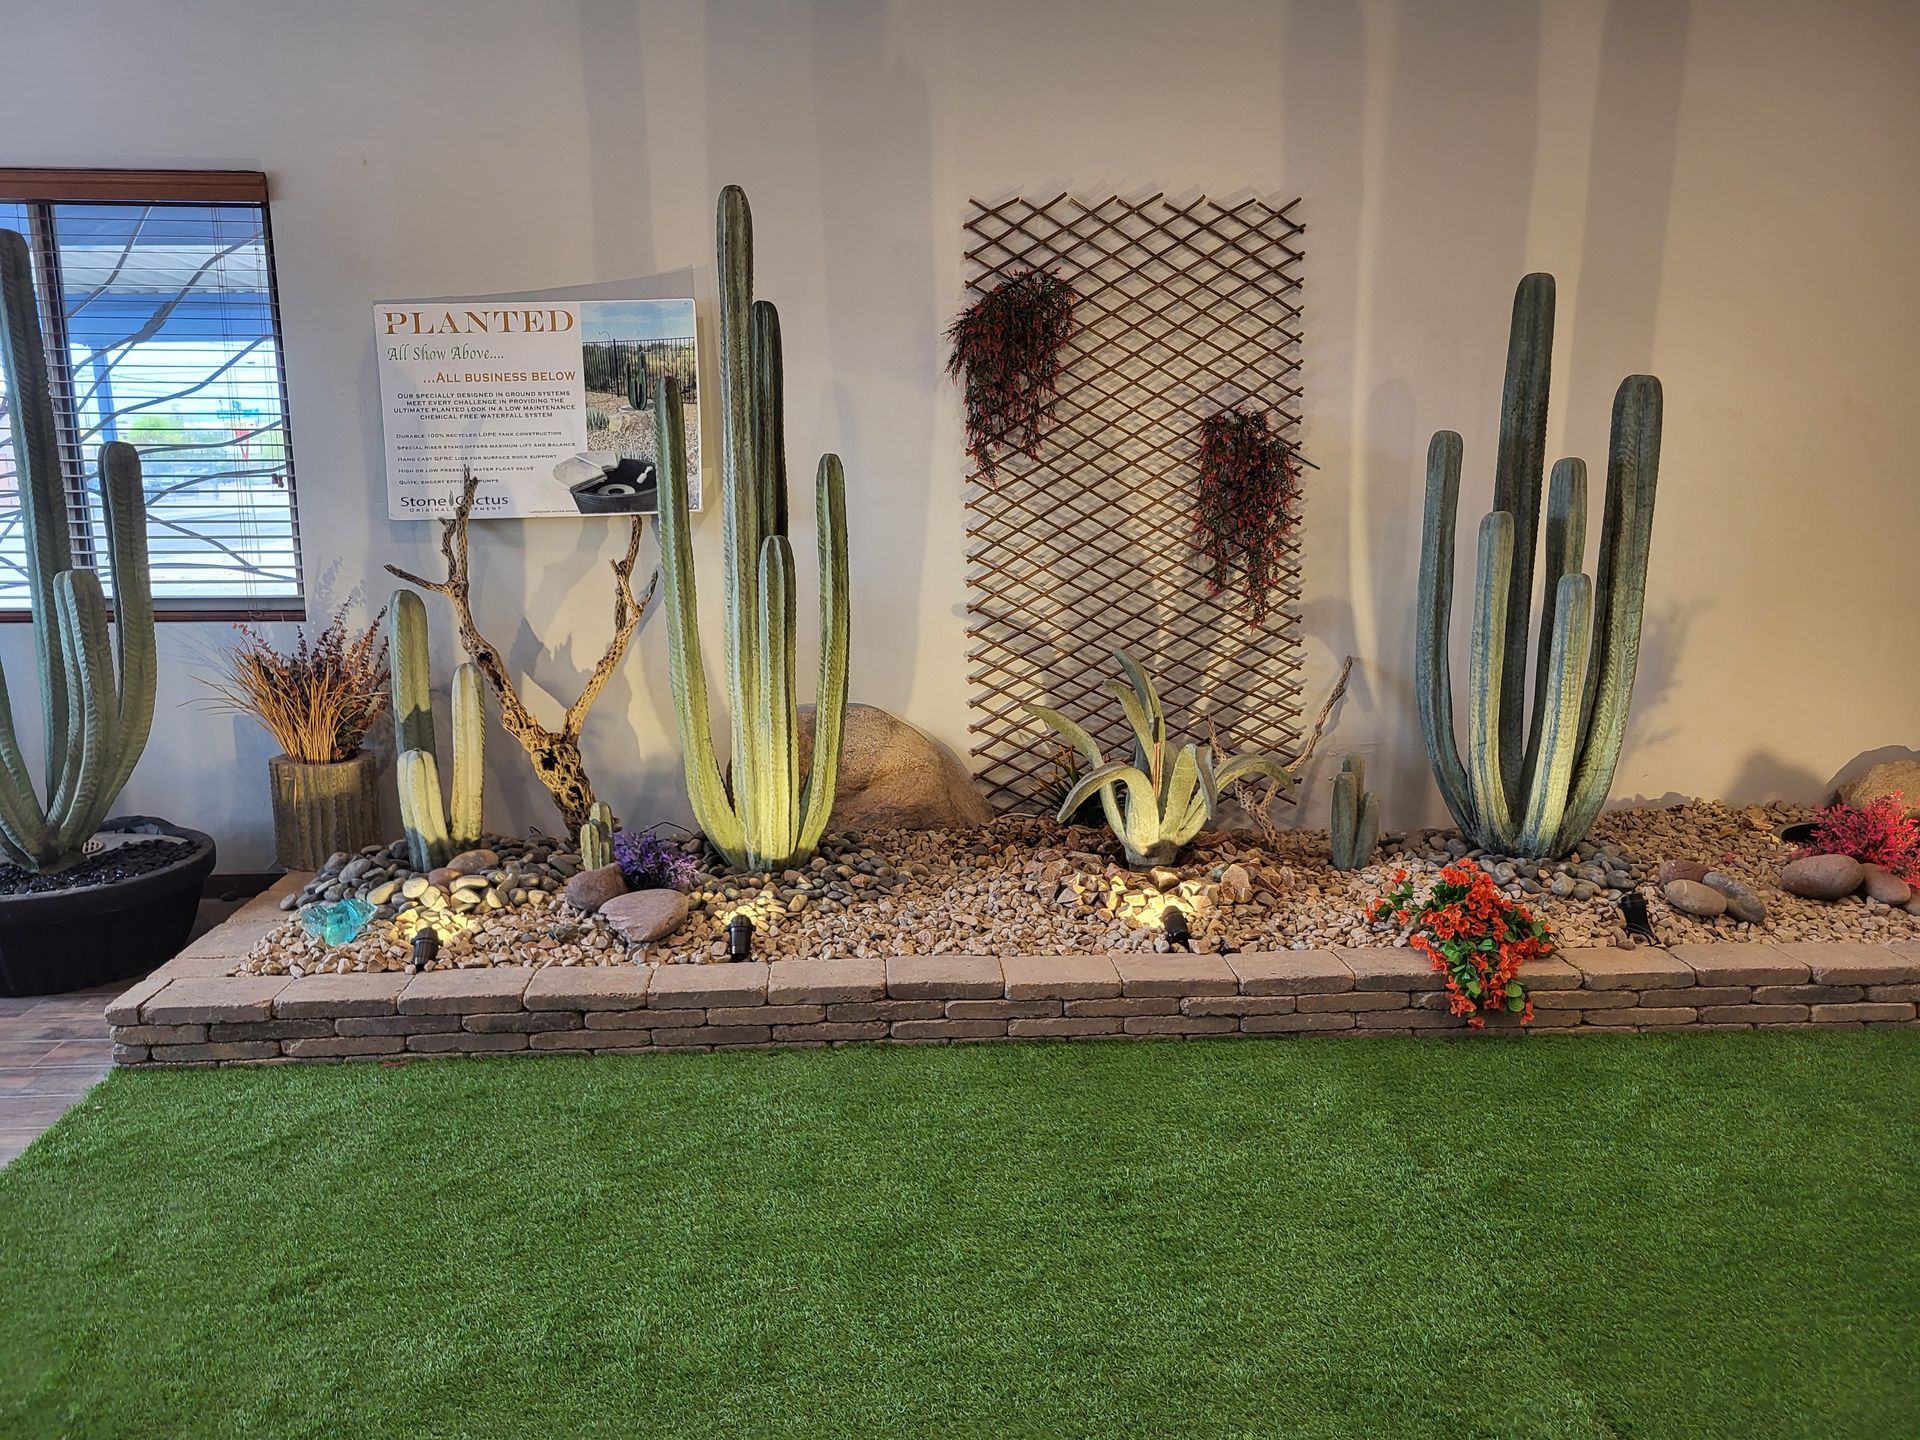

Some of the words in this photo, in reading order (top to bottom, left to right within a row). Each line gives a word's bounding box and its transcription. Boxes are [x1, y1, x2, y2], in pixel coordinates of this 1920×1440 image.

[383, 309, 574, 335] PLANTED
[387, 344, 410, 361] All
[413, 345, 446, 361] Show
[422, 372, 461, 384] ...ALL
[464, 373, 527, 383] BUSINESS
[531, 371, 576, 382] BELOW
[400, 495, 447, 507] Stone
[455, 495, 509, 506] Cctus
